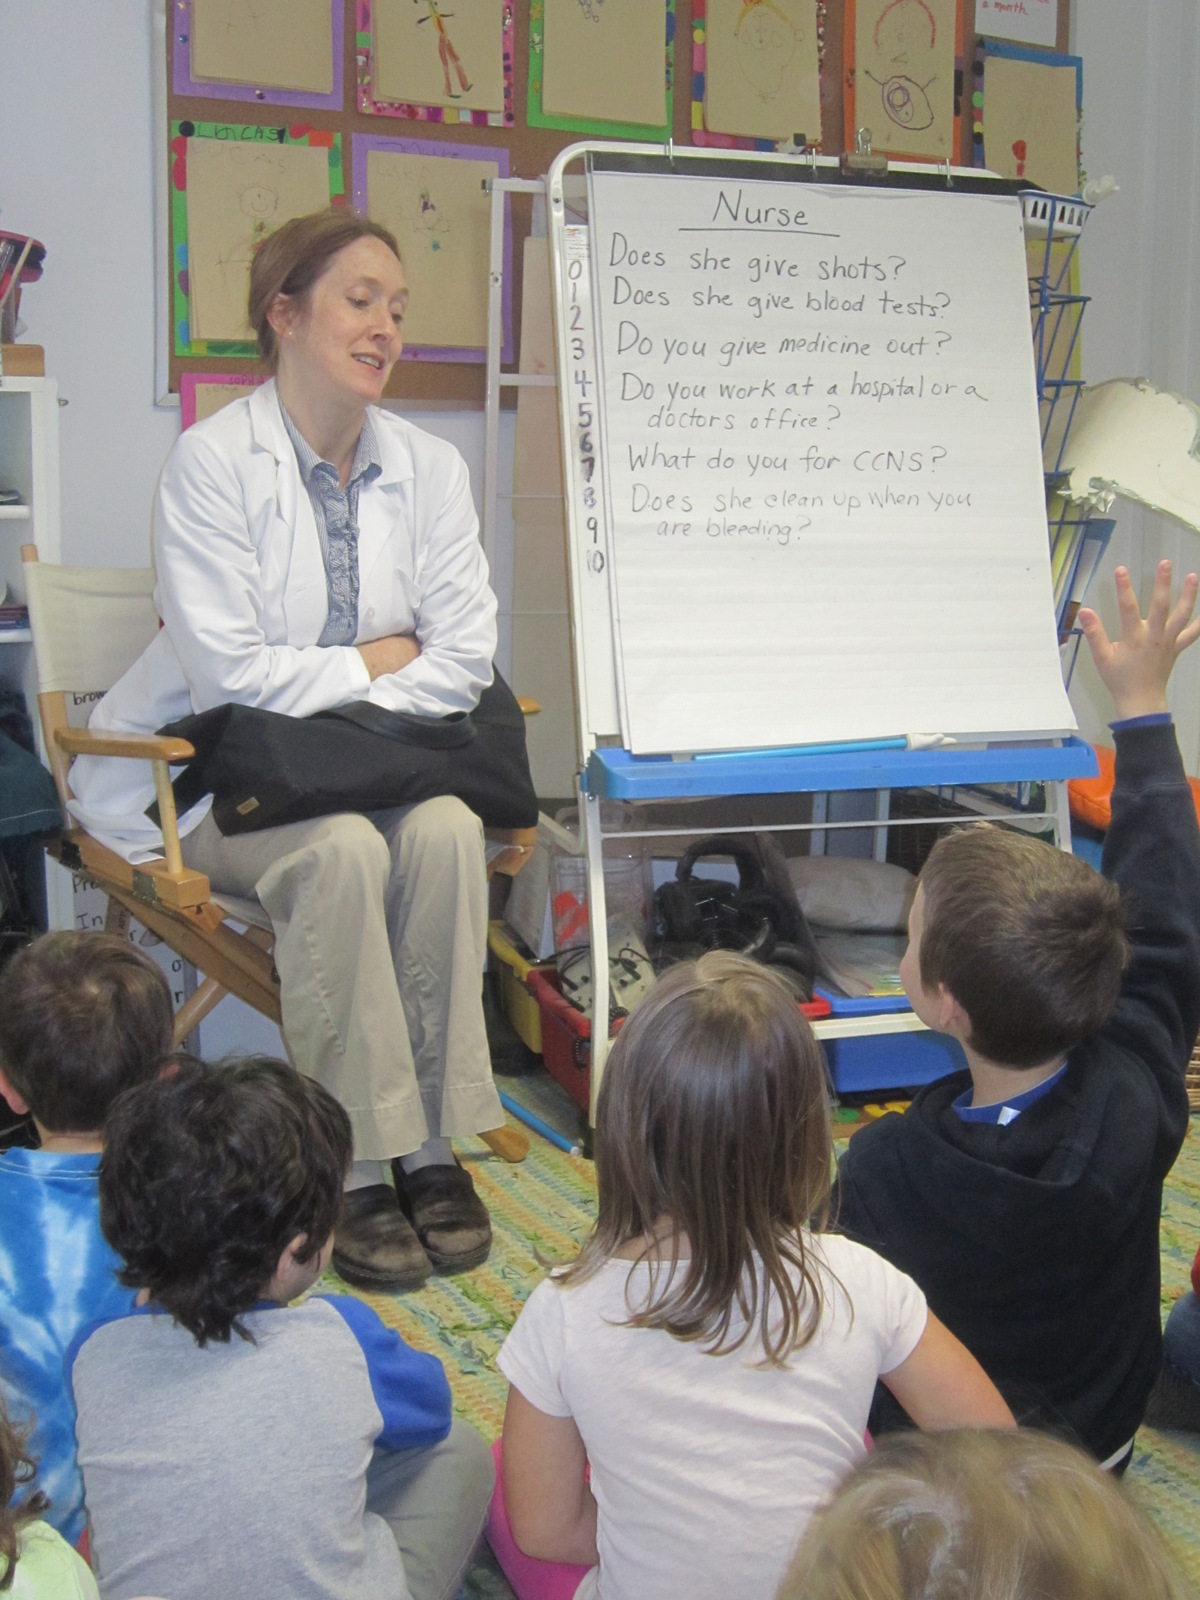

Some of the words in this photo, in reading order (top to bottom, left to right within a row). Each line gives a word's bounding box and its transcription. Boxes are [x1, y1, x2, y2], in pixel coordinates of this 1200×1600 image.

[712, 189, 809, 227] Nurse
[568, 260, 582, 280] 0
[609, 232, 666, 267] Does
[689, 247, 731, 270] she
[748, 254, 799, 283] give
[818, 255, 906, 281] shots?
[613, 275, 670, 306] Does
[692, 285, 733, 306] she
[747, 293, 794, 318] give
[806, 290, 865, 312] blood
[878, 290, 951, 319] tests?
[570, 305, 584, 331] 2
[571, 337, 585, 360] 3
[617, 320, 653, 356] Do
[663, 338, 707, 364] you
[718, 337, 767, 367] give
[778, 332, 871, 356] medicine
[886, 331, 952, 356] out?
[574, 370, 593, 397] 4
[621, 372, 654, 401] Do
[667, 381, 707, 411] you
[719, 379, 776, 400] work
[785, 376, 814, 396] at
[826, 383, 838, 396] a
[850, 371, 924, 402] hospital
[931, 380, 957, 396] or
[964, 385, 989, 401] a
[578, 402, 592, 428] 5
[647, 405, 736, 430] doctors
[750, 404, 842, 430] office?
[580, 431, 593, 453] 6
[580, 456, 595, 483] 7
[628, 441, 696, 472] What
[706, 448, 735, 469] do
[747, 454, 788, 477] you
[800, 445, 841, 472] for
[853, 445, 948, 473] CCNS?
[584, 486, 597, 508] 8
[631, 483, 693, 513] Does
[713, 486, 752, 512] she
[764, 489, 823, 508] clean
[833, 491, 862, 517] up
[868, 484, 920, 508] when
[927, 491, 972, 512] you
[587, 516, 598, 544] 9
[656, 520, 692, 537] are
[706, 514, 812, 546] bleeding?
